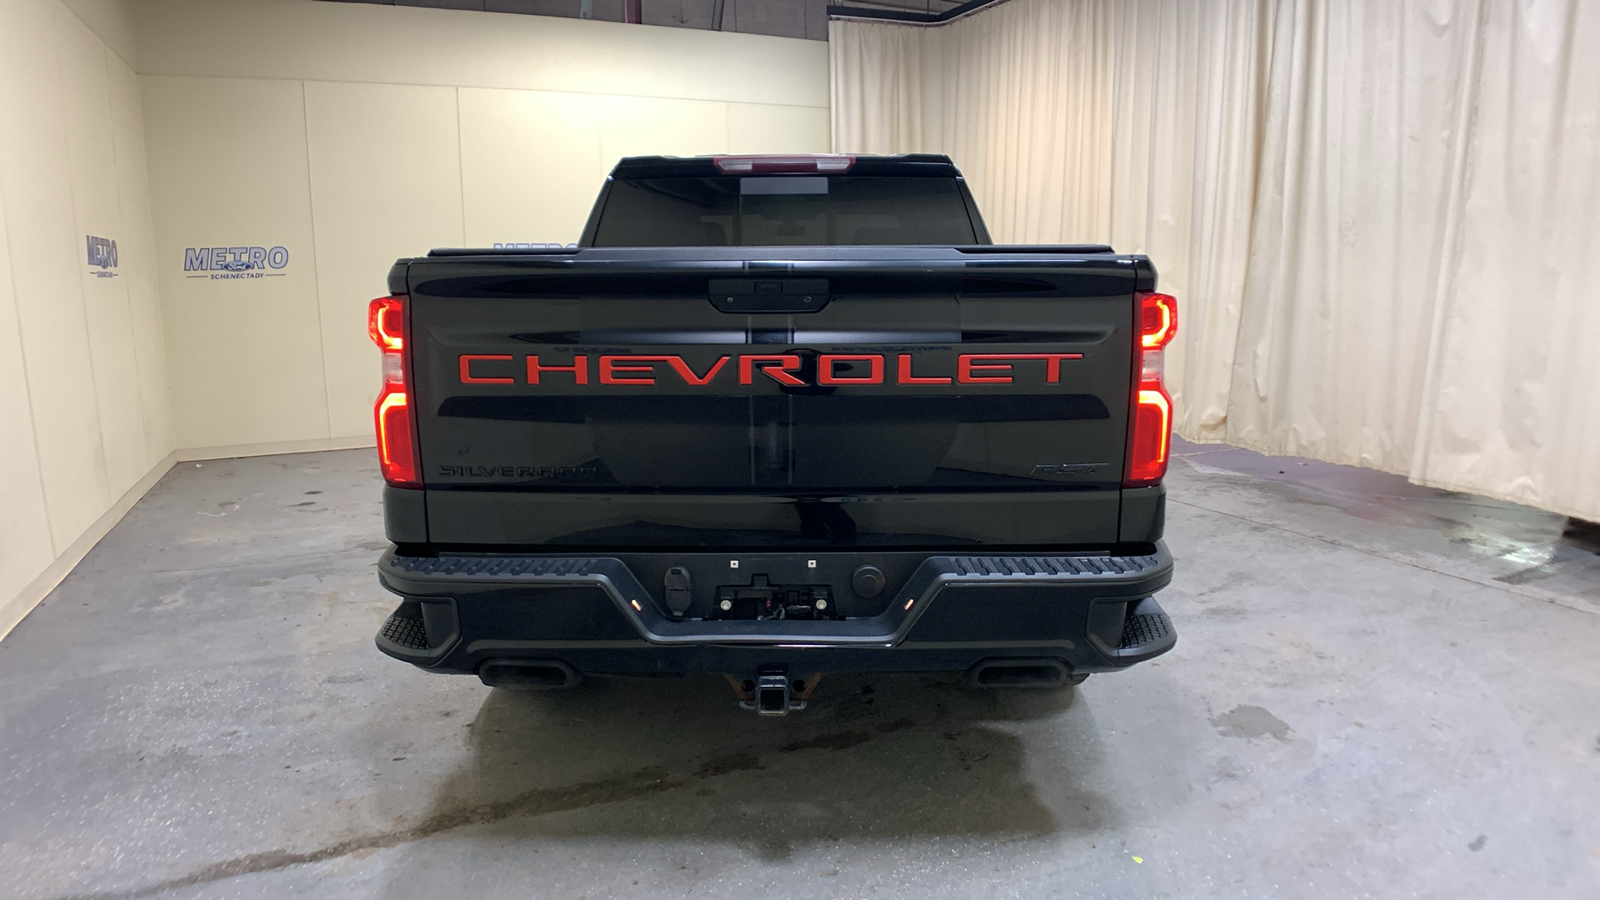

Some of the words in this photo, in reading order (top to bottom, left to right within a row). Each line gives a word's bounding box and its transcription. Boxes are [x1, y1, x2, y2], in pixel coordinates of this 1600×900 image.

[86, 235, 118, 268] METRO
[184, 246, 289, 271] METRO
[210, 272, 265, 280] SCHENECTADY
[227, 263, 247, 271] Ford
[459, 354, 1084, 386] CHEVROLET
